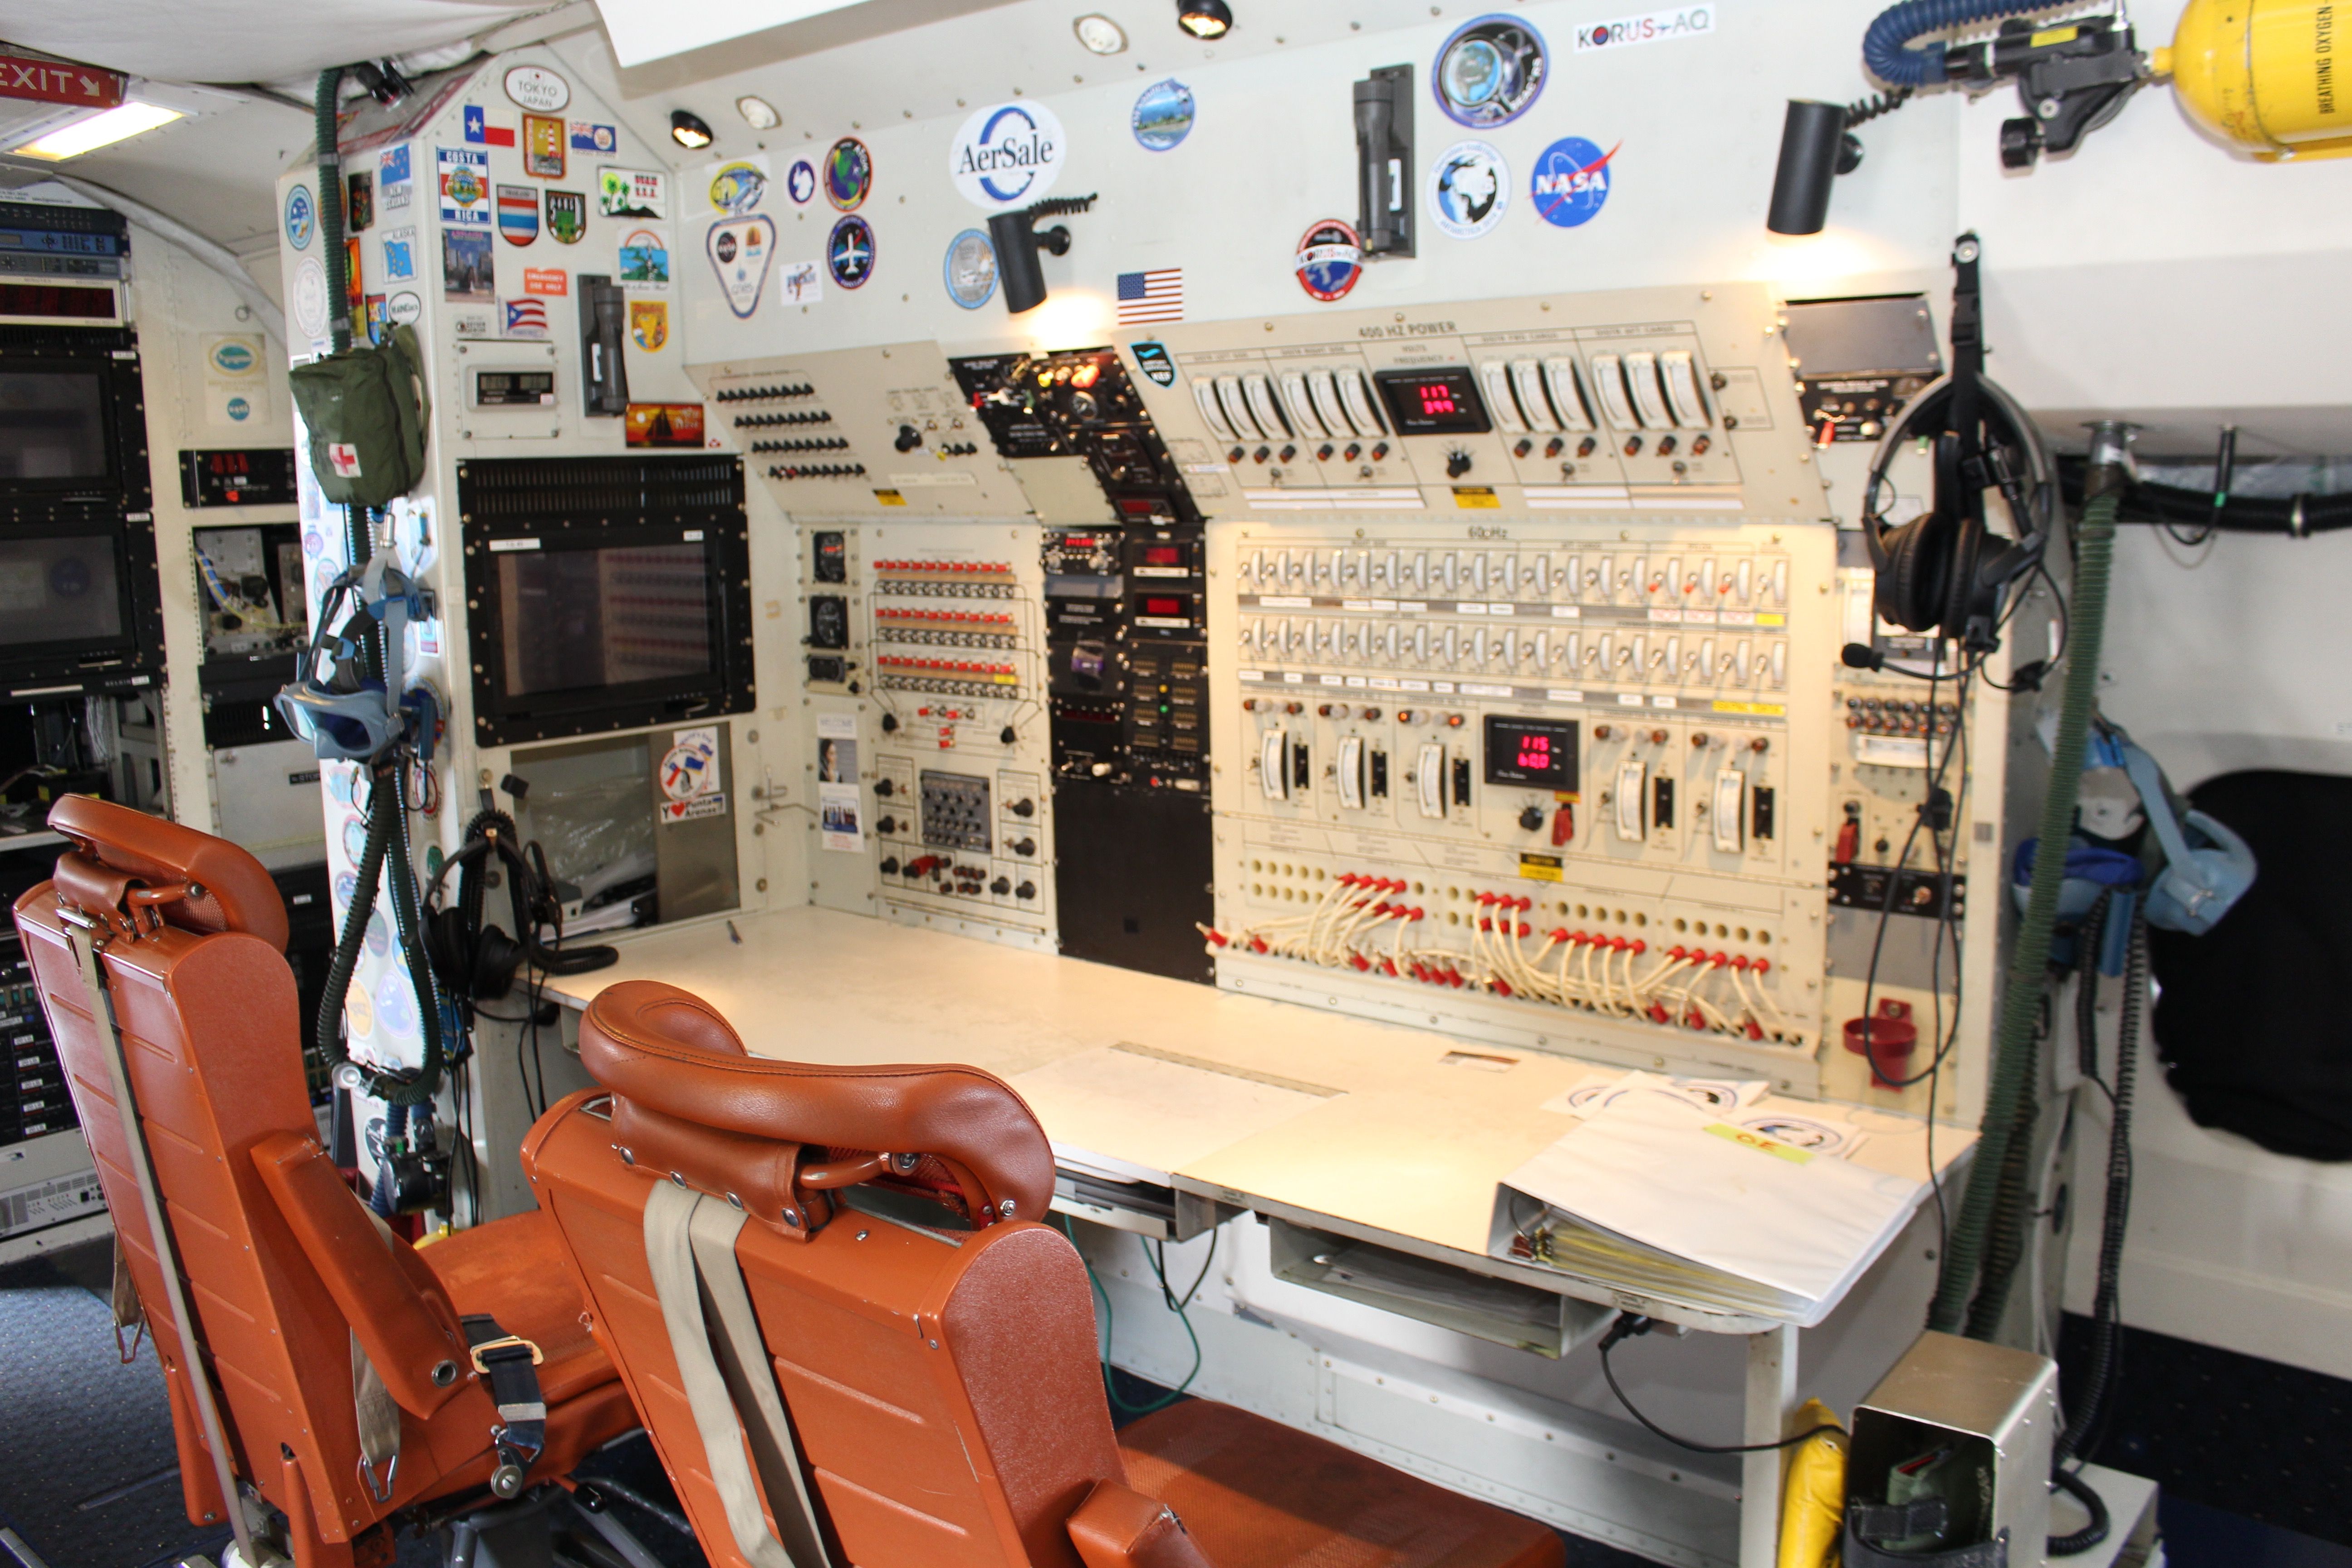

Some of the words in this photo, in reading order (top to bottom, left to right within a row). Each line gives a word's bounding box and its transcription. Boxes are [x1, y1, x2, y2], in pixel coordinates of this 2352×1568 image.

[518, 80, 557, 97] TOKYO
[2317, 57, 2336, 114] BREATHING
[523, 95, 553, 108] JAPAN
[446, 151, 479, 165] COSTA
[958, 134, 1054, 174] AerSale
[1535, 170, 1607, 195] NASA
[455, 210, 480, 221] RICA
[1358, 326, 1384, 338] 400
[1407, 321, 1458, 335] POWER
[1421, 385, 1449, 399] 117
[1522, 735, 1549, 751] 115
